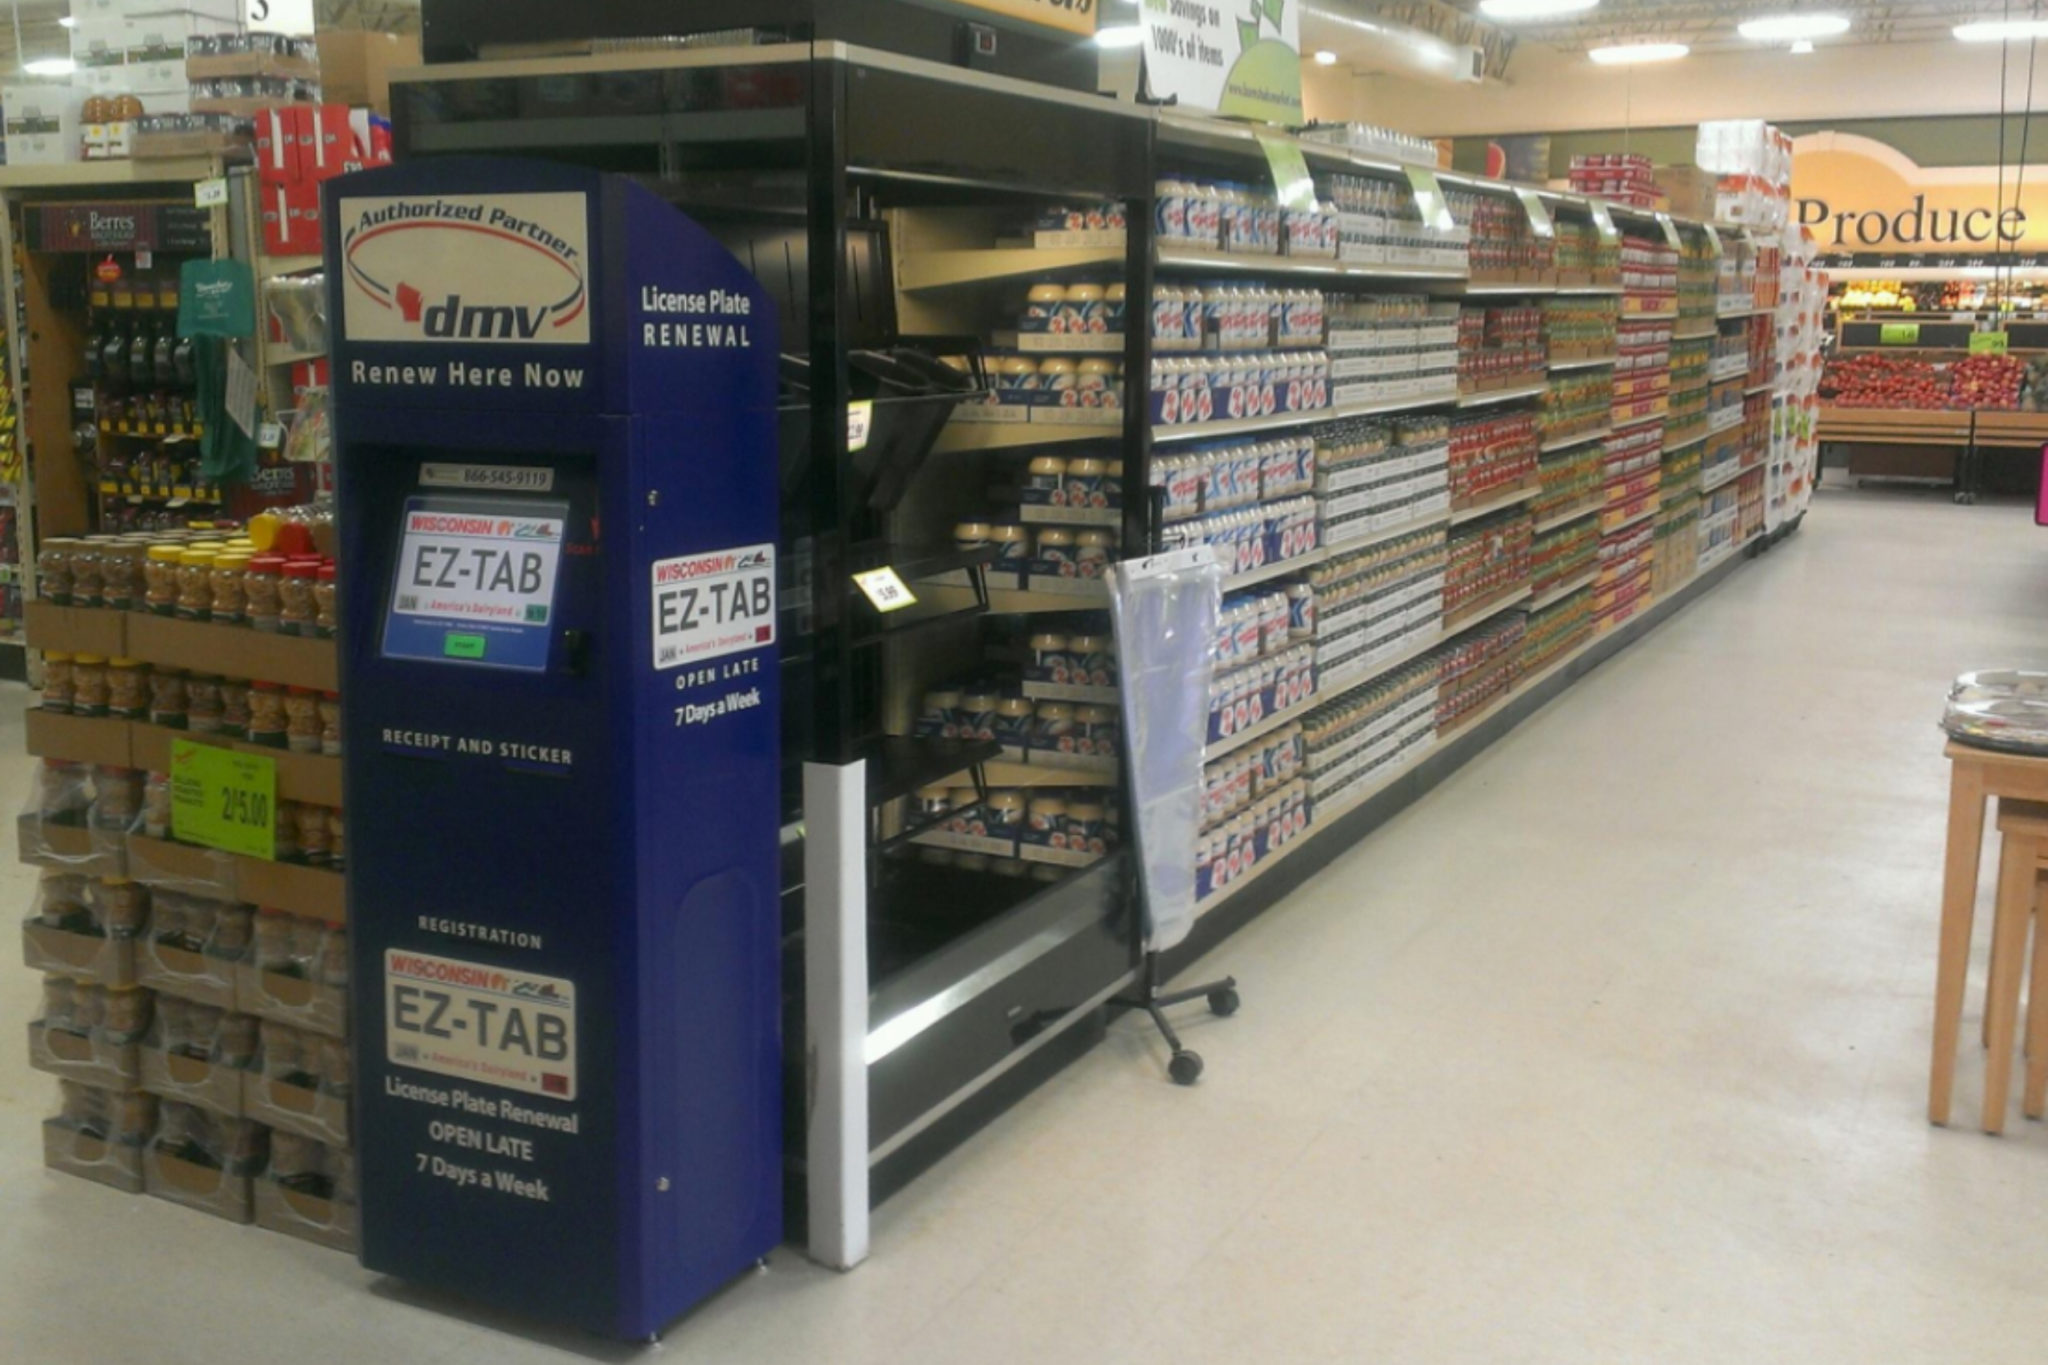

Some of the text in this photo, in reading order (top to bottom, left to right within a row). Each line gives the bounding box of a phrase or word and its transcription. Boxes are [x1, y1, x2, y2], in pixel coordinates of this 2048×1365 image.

[1208, 7, 1221, 27] on
[1152, 24, 1223, 67] 1000's of items
[90, 210, 135, 230] Berres
[359, 200, 578, 259] Authorized Partner
[1795, 193, 2027, 245] Produce
[423, 294, 548, 339] dmv
[641, 285, 751, 315] License Plate
[643, 322, 751, 347] RENEWAL
[351, 360, 585, 388] Renew Here Now
[463, 467, 548, 488] 866-545-9119
[410, 515, 493, 535] WISCONSIN
[412, 544, 543, 595] EZ-TAB
[656, 556, 722, 583] WISCONSIN
[658, 576, 772, 635] EZ-TAB
[675, 657, 760, 690] OPEN LATE
[675, 687, 761, 727] 7 Days a Week
[382, 728, 573, 765] RECEIPT AND STICKER
[418, 914, 543, 950] REGISTRATION
[391, 954, 489, 988] WISCONSIN
[393, 983, 569, 1062] EZ-TAB
[385, 1075, 579, 1135] License Plate Renewal
[428, 1120, 534, 1161] OPEN LATE
[416, 1152, 549, 1202] 7 Days a Week
